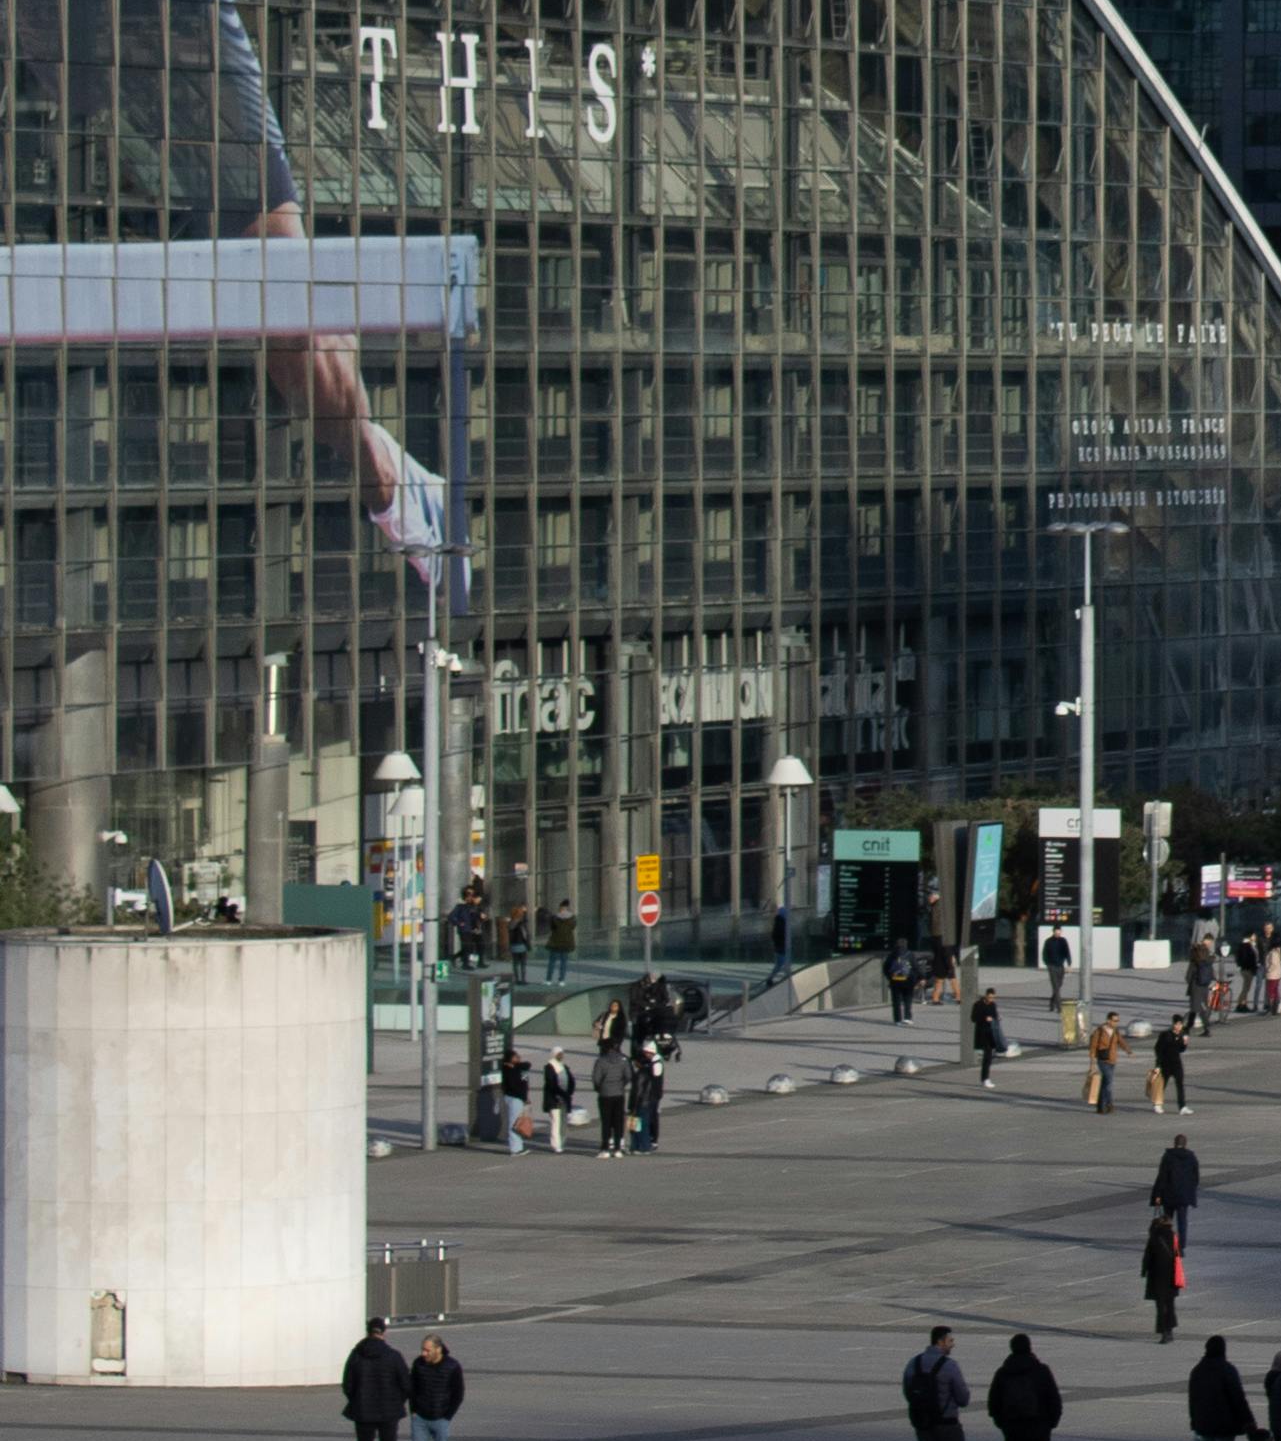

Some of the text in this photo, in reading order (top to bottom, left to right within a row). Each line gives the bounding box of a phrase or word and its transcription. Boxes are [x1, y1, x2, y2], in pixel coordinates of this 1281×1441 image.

[1091, 321, 1133, 343] PEUX
[1145, 323, 1164, 343] LE
[492, 658, 596, 734] fnac
[861, 836, 891, 853] cnit
